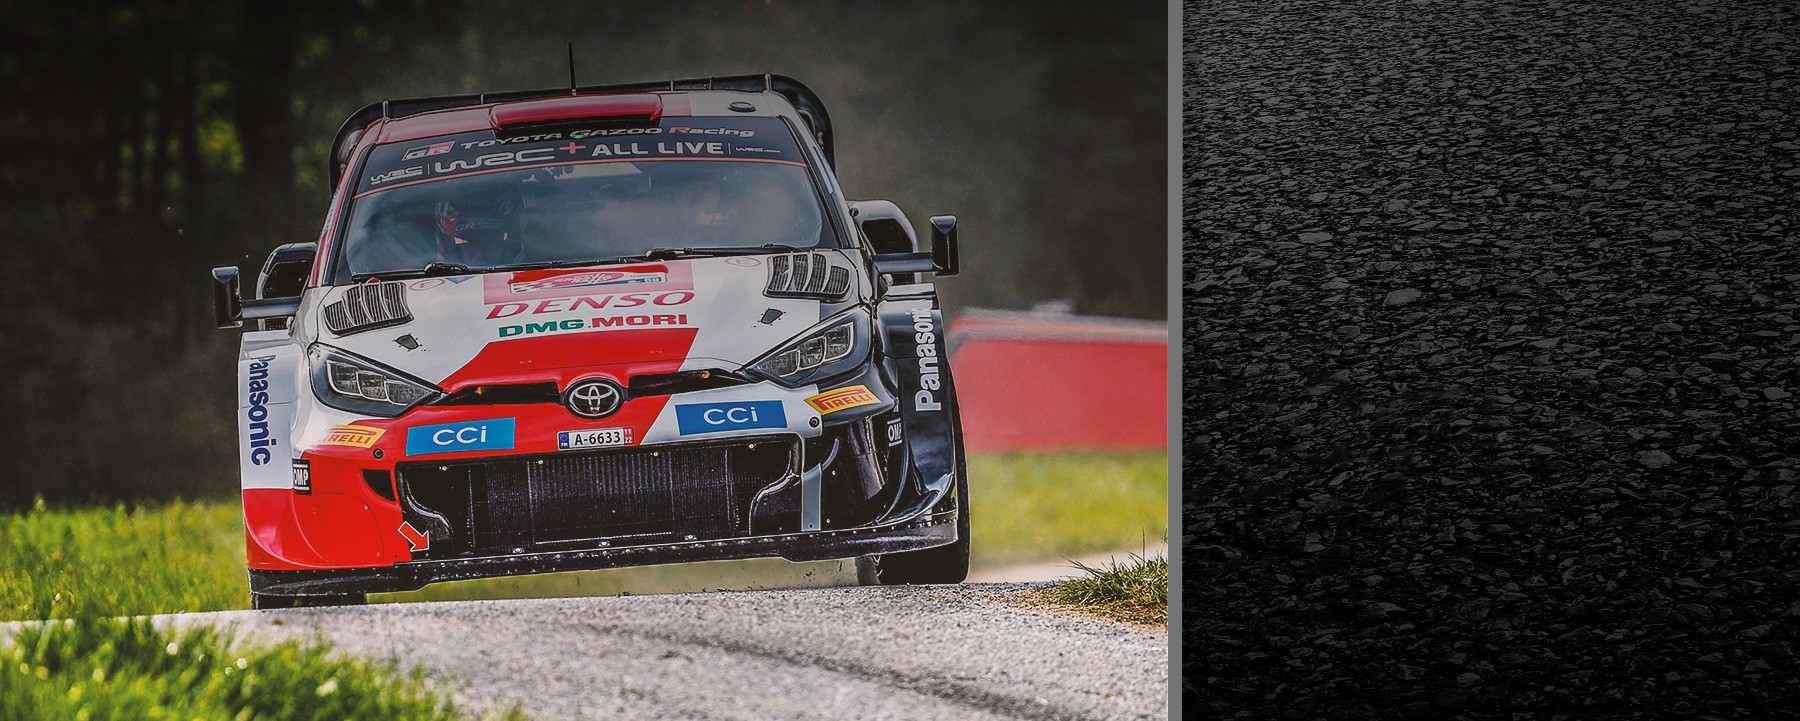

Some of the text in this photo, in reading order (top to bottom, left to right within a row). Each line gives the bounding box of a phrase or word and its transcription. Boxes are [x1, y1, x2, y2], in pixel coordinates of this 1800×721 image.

[460, 132, 562, 149] TOYOTA
[570, 127, 663, 139] GAZOO
[668, 126, 755, 137] Racing
[591, 142, 649, 157] ALL
[657, 141, 724, 155] LIVE
[485, 291, 695, 320] DENSO
[247, 354, 277, 466] Panasonic
[811, 388, 875, 411] PIRELLI
[574, 431, 621, 446] A-6633
